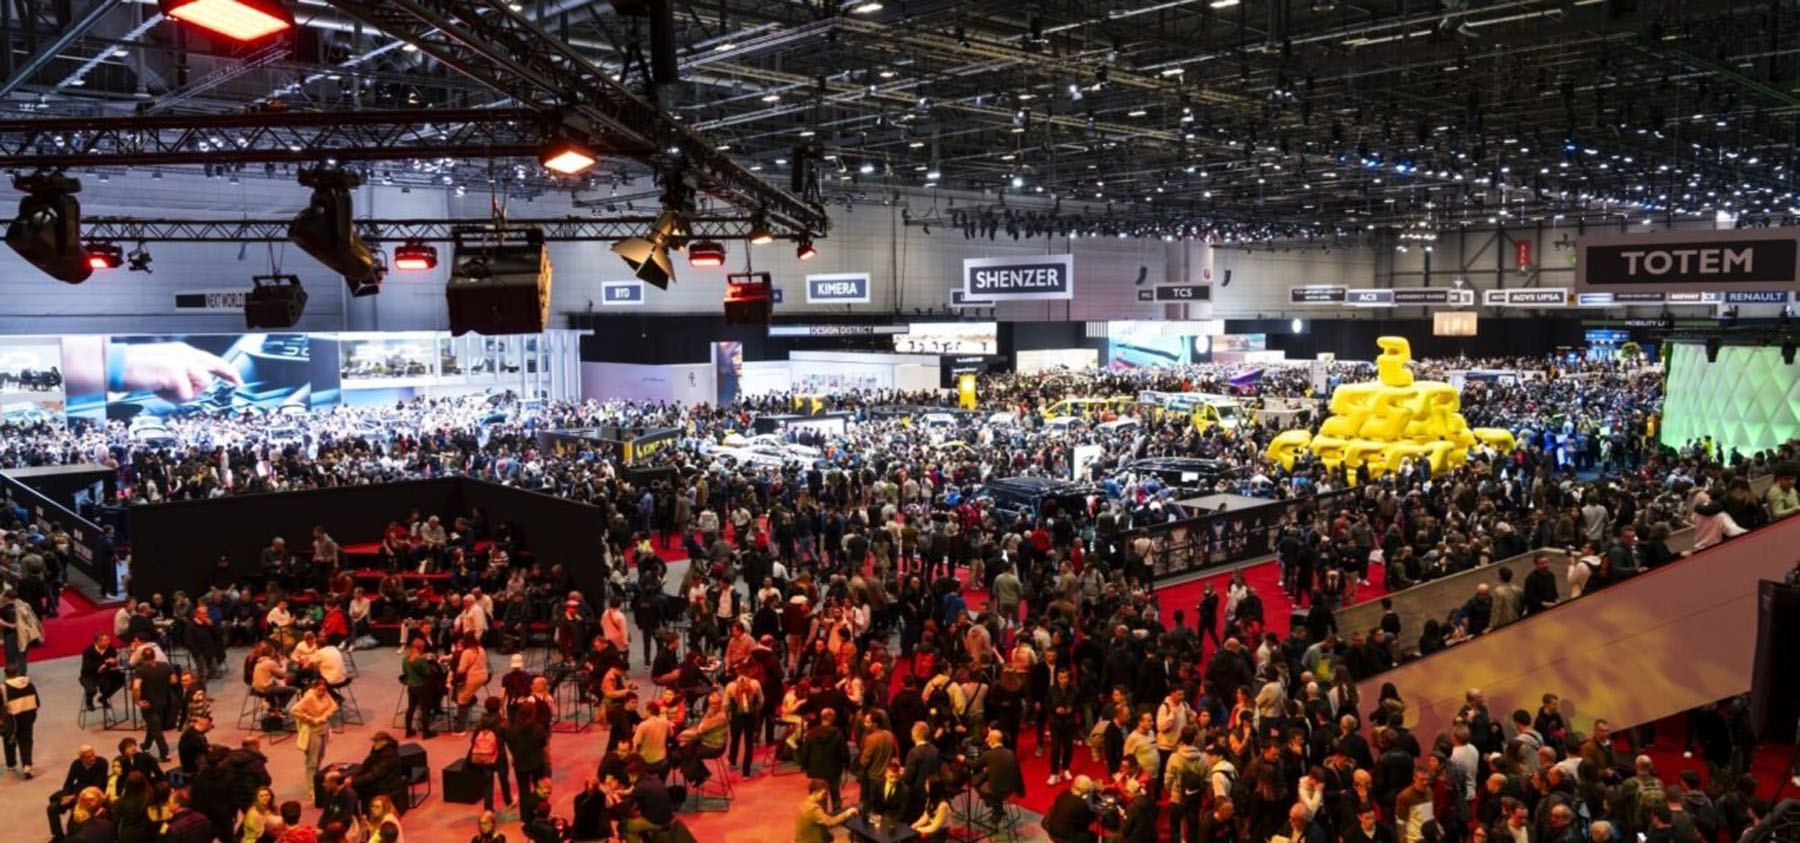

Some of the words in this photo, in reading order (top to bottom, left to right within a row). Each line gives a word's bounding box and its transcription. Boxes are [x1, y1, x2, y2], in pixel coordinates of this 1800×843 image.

[1621, 248, 1754, 275] TOTEM
[976, 268, 1059, 289] SHENZER
[817, 282, 857, 295] KIMERA
[1173, 288, 1193, 297] TCS
[1358, 293, 1377, 301] ACS
[1537, 293, 1560, 301] UPSA
[1729, 292, 1784, 302] RENAULT
[811, 325, 838, 335] DESIGN
[840, 325, 873, 334] DISTRICT
